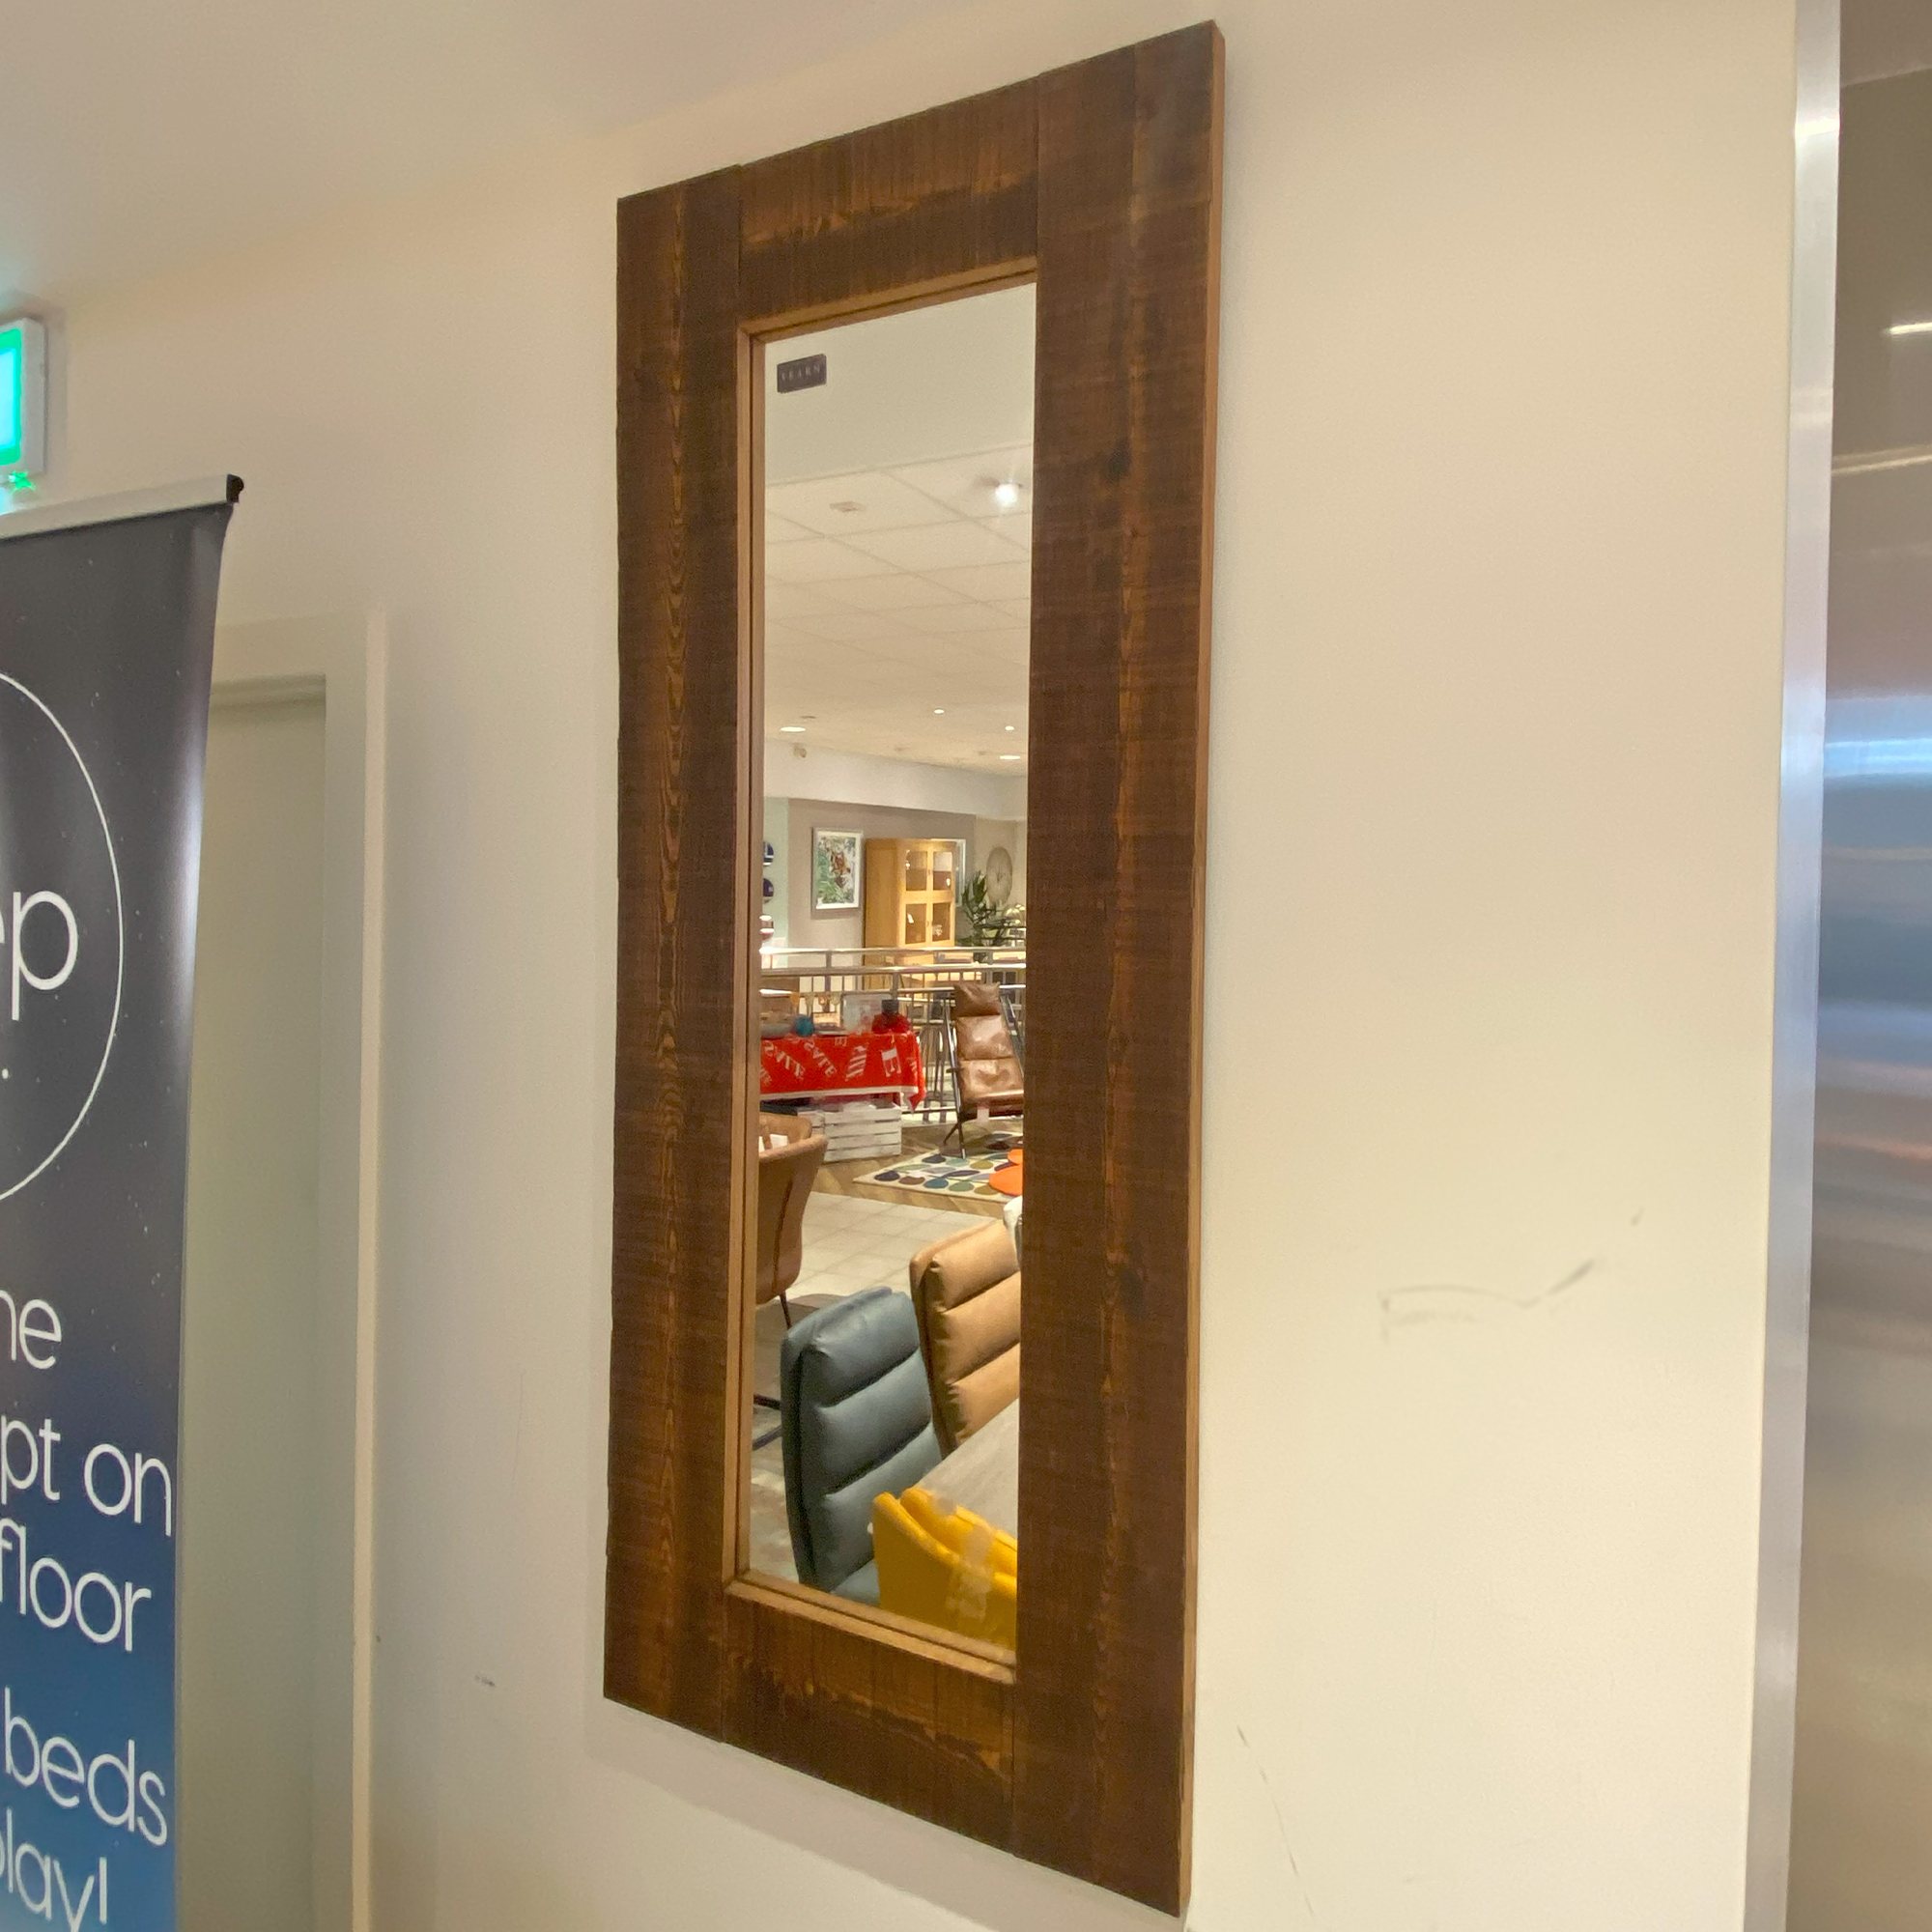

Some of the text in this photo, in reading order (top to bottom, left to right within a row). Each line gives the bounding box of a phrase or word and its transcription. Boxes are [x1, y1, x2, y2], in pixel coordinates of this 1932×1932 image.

[0, 891, 78, 1021] p
[84, 1443, 172, 1537] on
[0, 1518, 152, 1652] floor
[4, 1688, 167, 1846] beds
[0, 1806, 107, 1932] lay!
